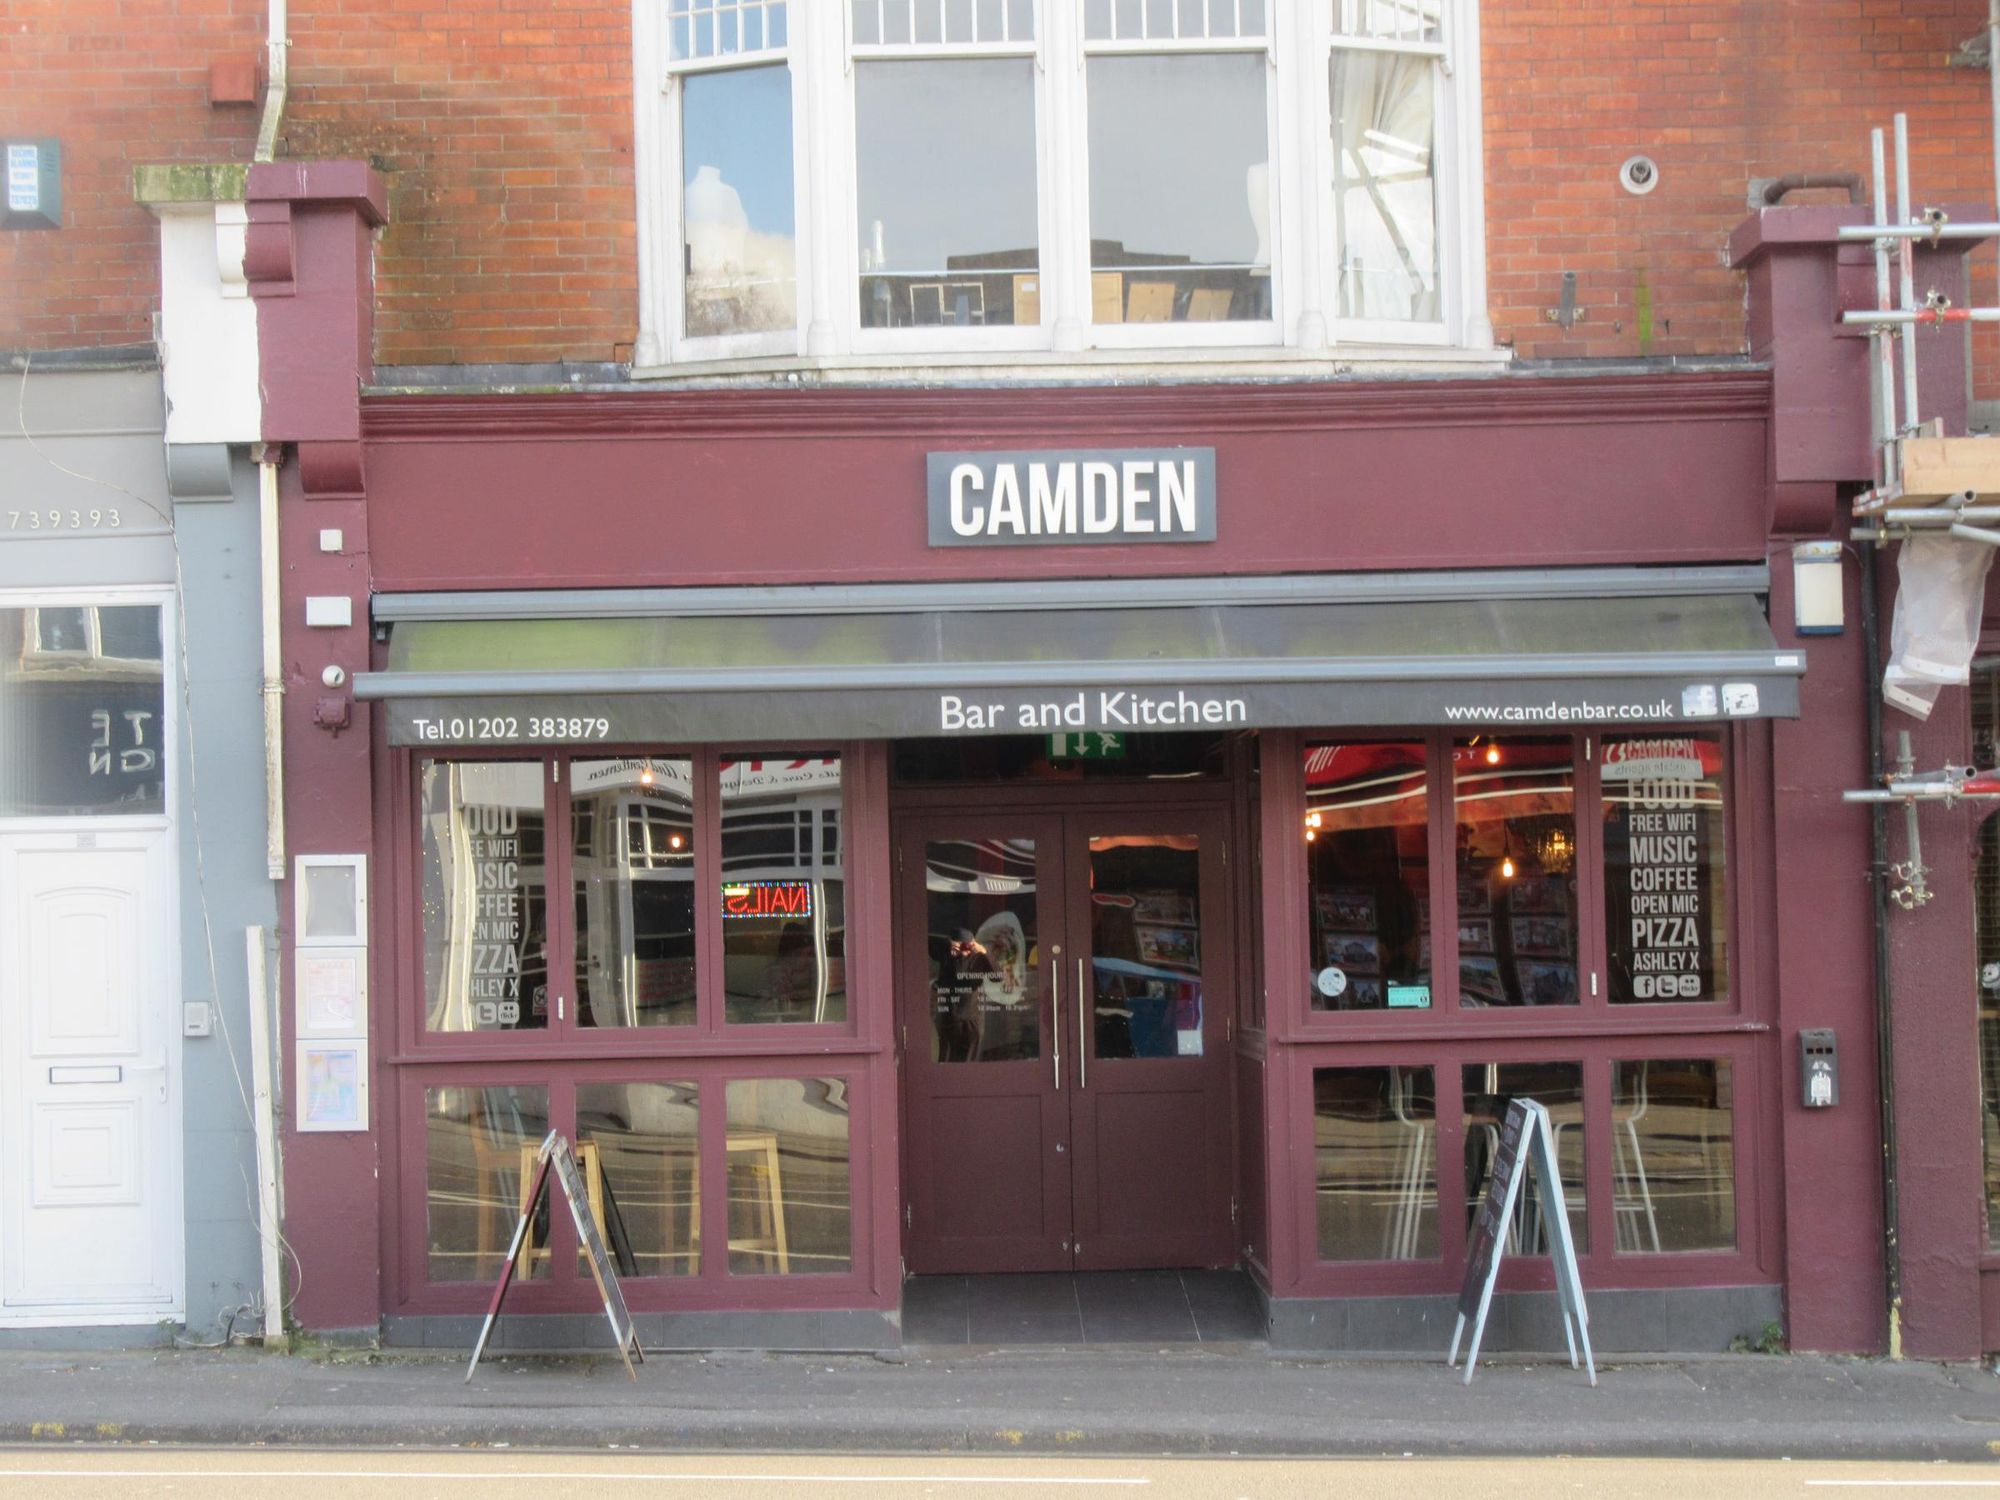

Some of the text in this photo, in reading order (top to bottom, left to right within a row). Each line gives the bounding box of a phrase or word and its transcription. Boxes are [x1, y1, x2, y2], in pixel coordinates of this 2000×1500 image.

[949, 460, 1196, 537] CAMDEN
[8, 508, 121, 529] 739393
[941, 690, 1246, 730] Bar and Kitchen
[1445, 699, 1674, 720] www.camdenbar.co.uk
[413, 717, 609, 740] Tel.01202 383879
[1628, 779, 1696, 810] FOOD
[464, 803, 518, 836] OOD
[1629, 812, 1697, 832] FREE WIFI
[487, 839, 518, 858] WIFI
[1629, 835, 1698, 864] MUSIC
[474, 861, 519, 890] USIC
[1630, 867, 1699, 892] COFFEE
[475, 893, 519, 918] FFEE
[1631, 894, 1699, 915] OPEN MIC
[492, 921, 519, 940] MIC
[1632, 917, 1700, 948] PIZZA
[473, 944, 519, 974] ZZA
[1633, 951, 1700, 971] ASHLEY X
[956, 971, 984, 980] OPENING
[470, 978, 519, 998] HLEY X
